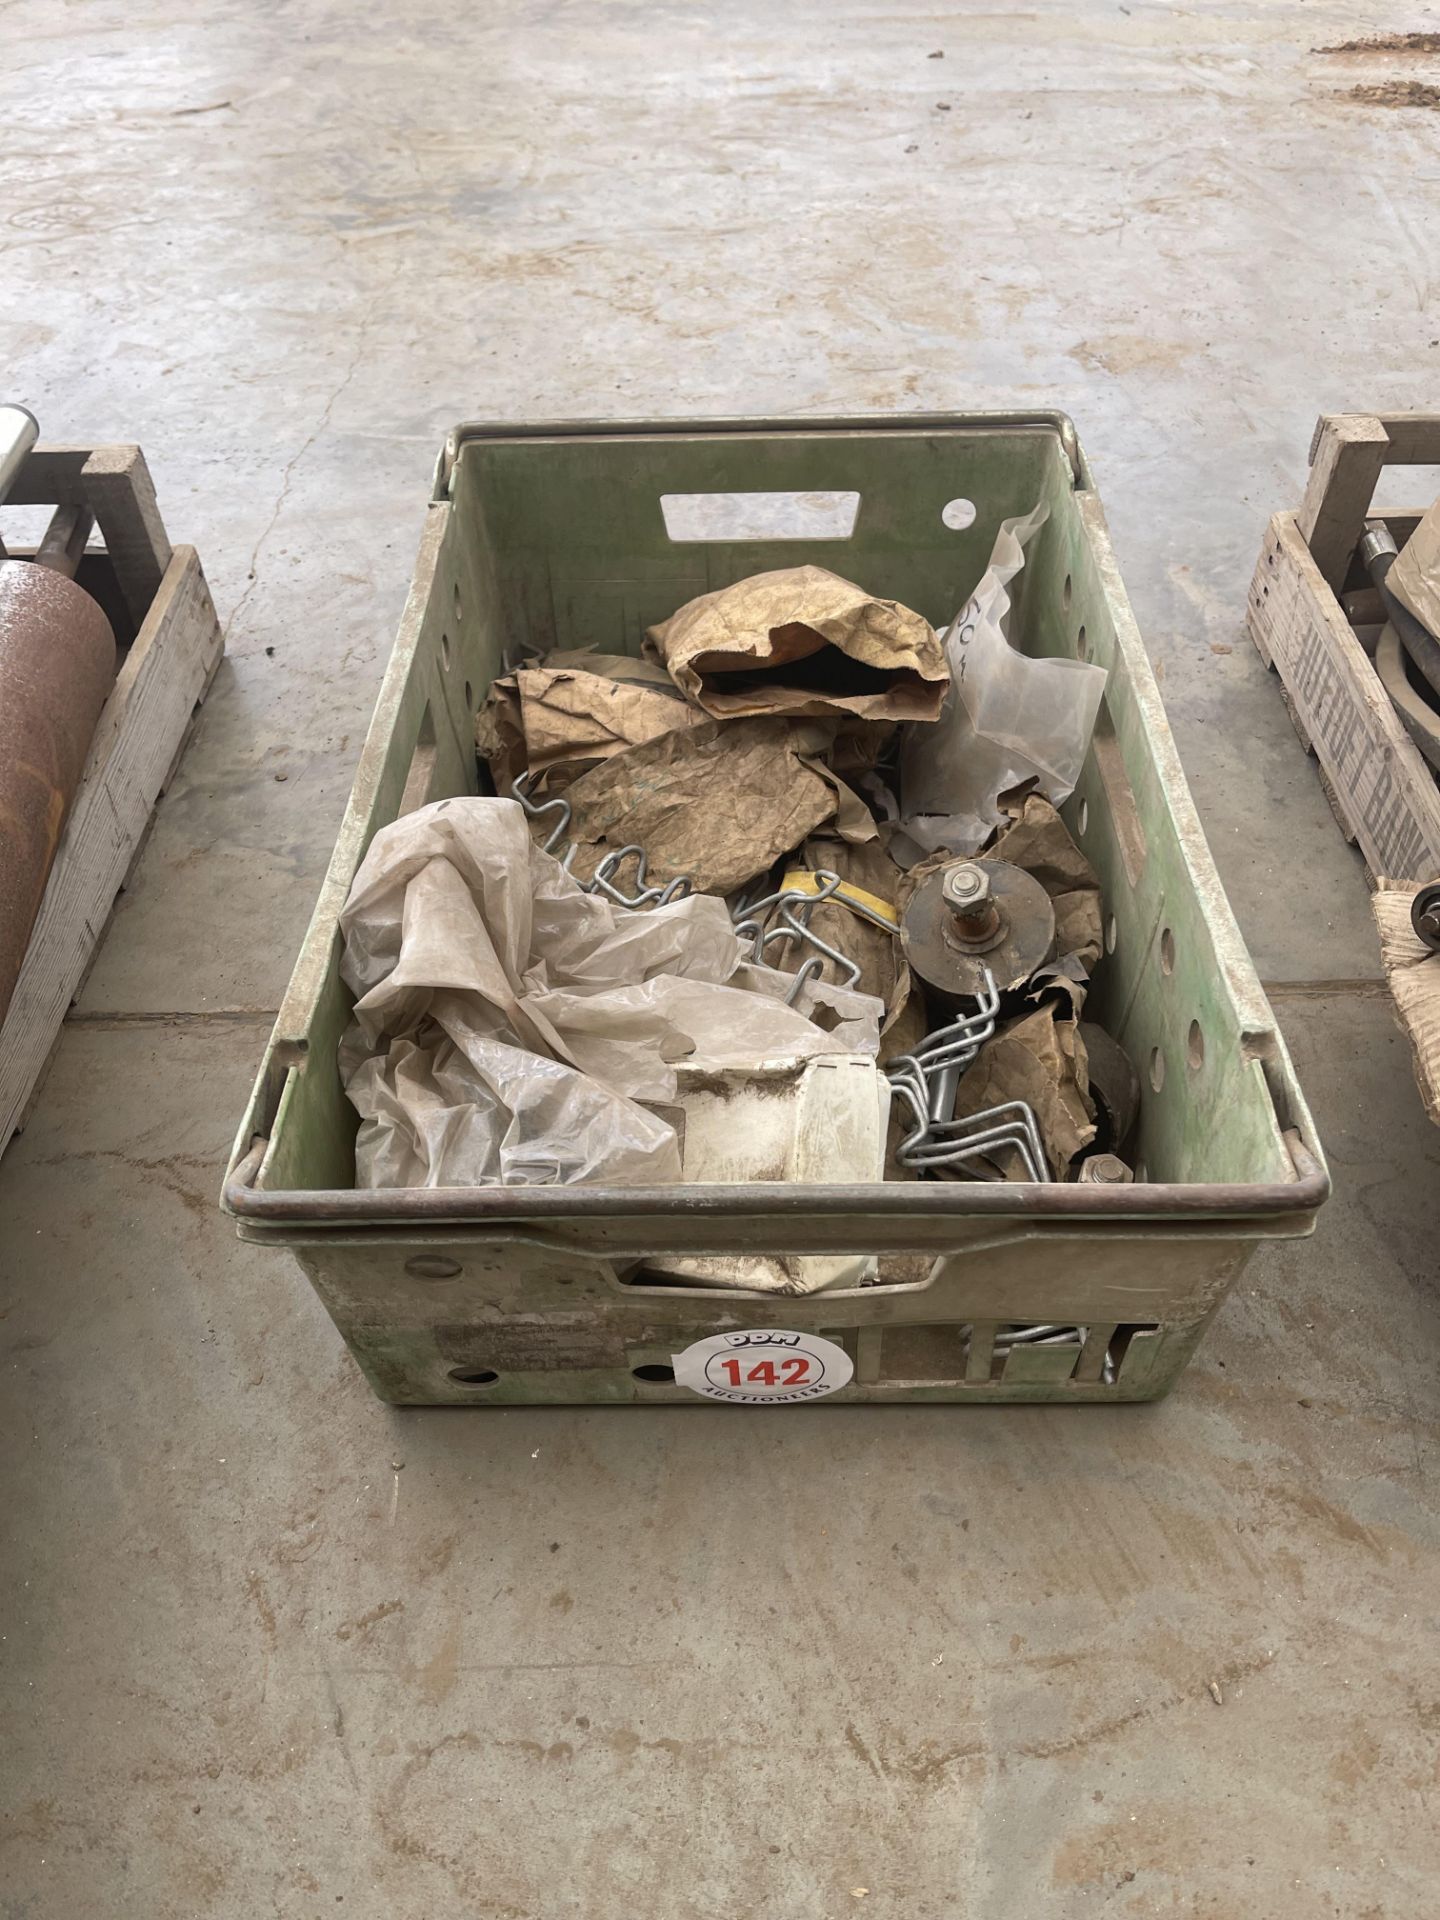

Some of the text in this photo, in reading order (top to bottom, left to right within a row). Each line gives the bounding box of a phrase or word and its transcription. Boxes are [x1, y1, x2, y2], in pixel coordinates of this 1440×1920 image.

[1362, 763, 1433, 880] BANK
[723, 1331, 801, 1347] DDM
[721, 1358, 811, 1387] 142
[701, 1383, 832, 1403] AUCTIONEERS
